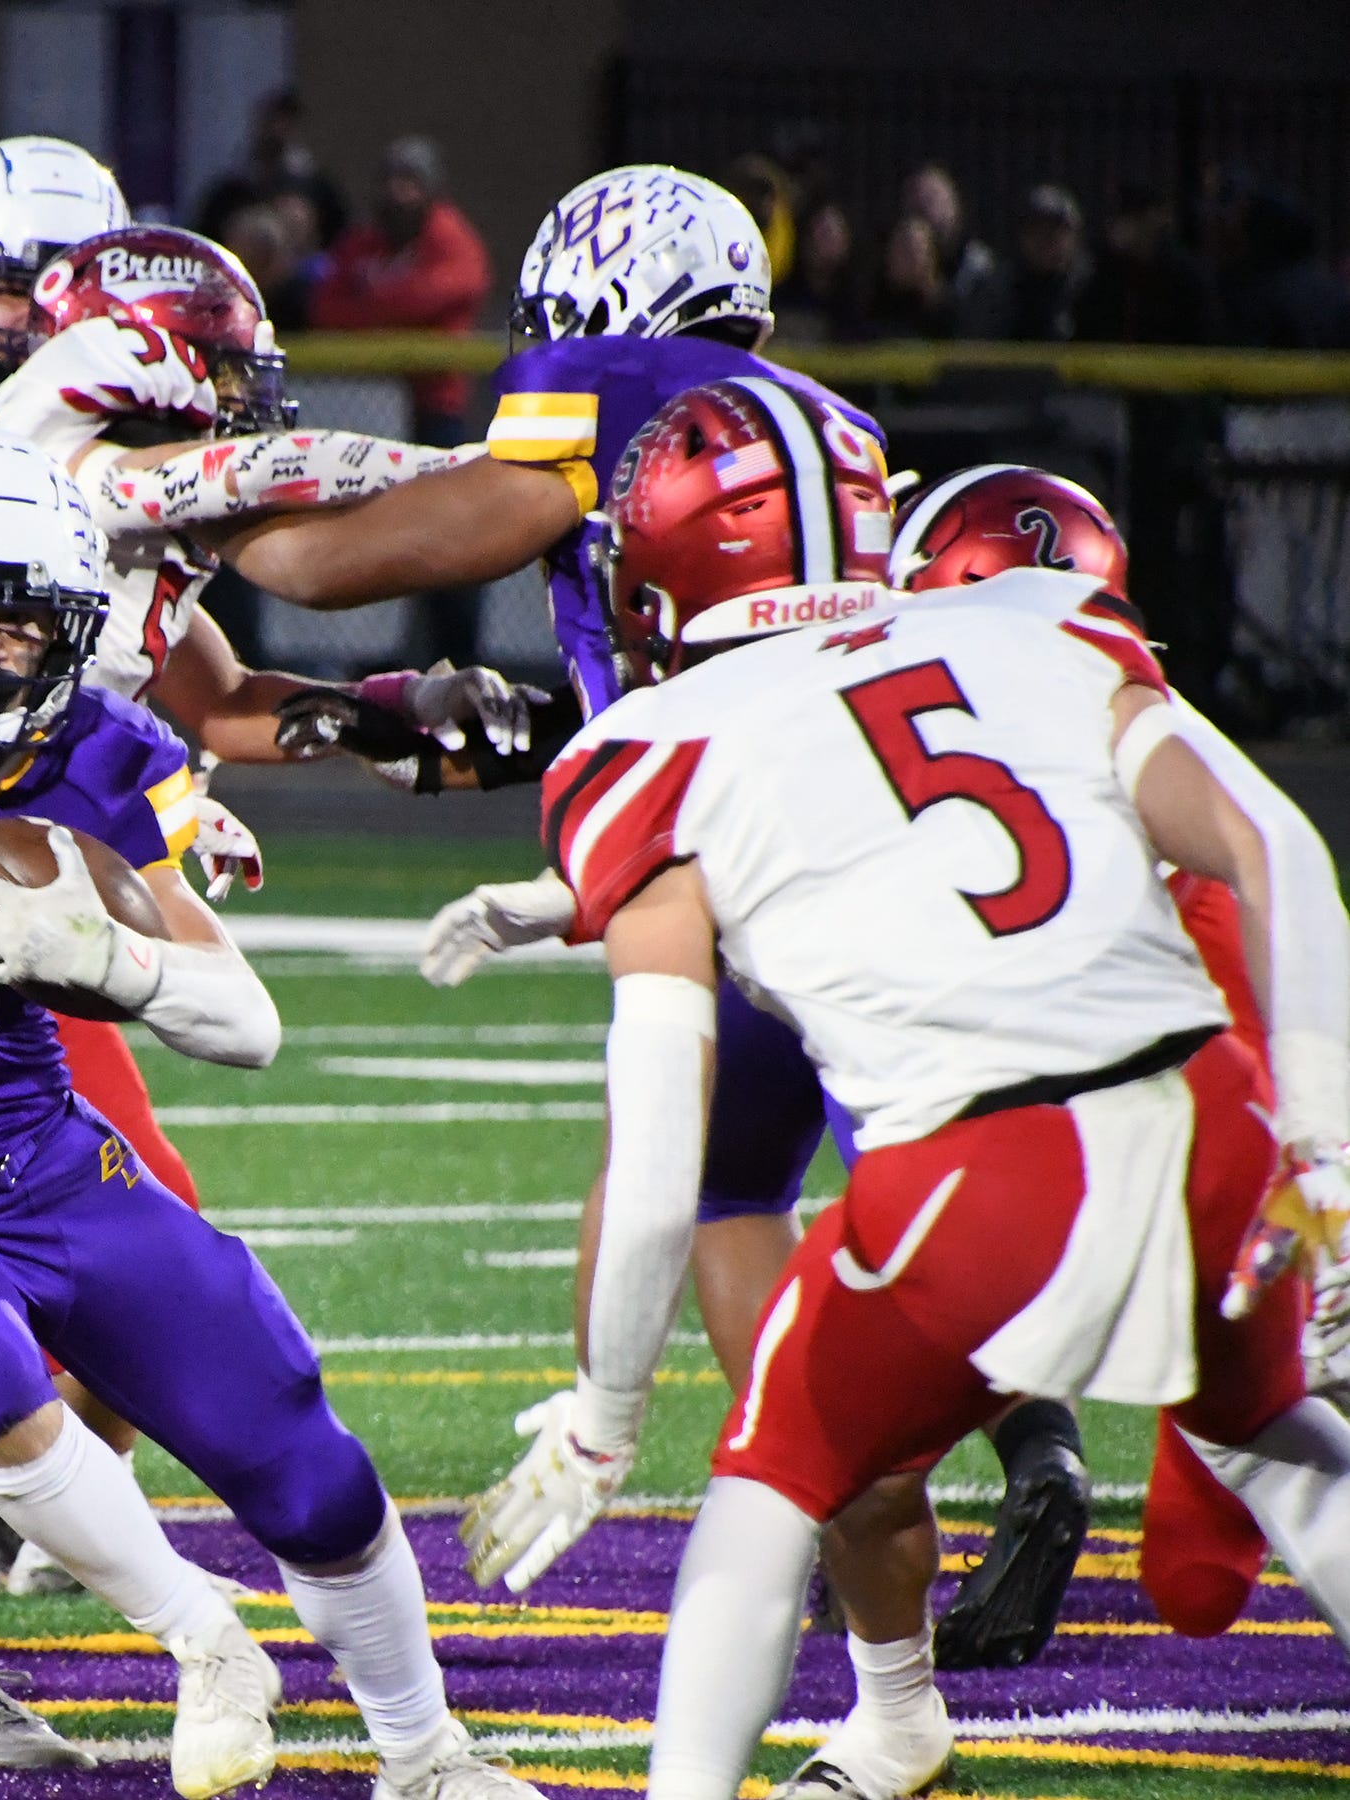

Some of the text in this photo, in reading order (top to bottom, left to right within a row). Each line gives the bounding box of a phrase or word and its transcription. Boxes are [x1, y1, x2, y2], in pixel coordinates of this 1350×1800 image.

[1015, 506, 1077, 573] 2
[748, 589, 876, 629] Riddell
[838, 658, 1072, 939] 5
